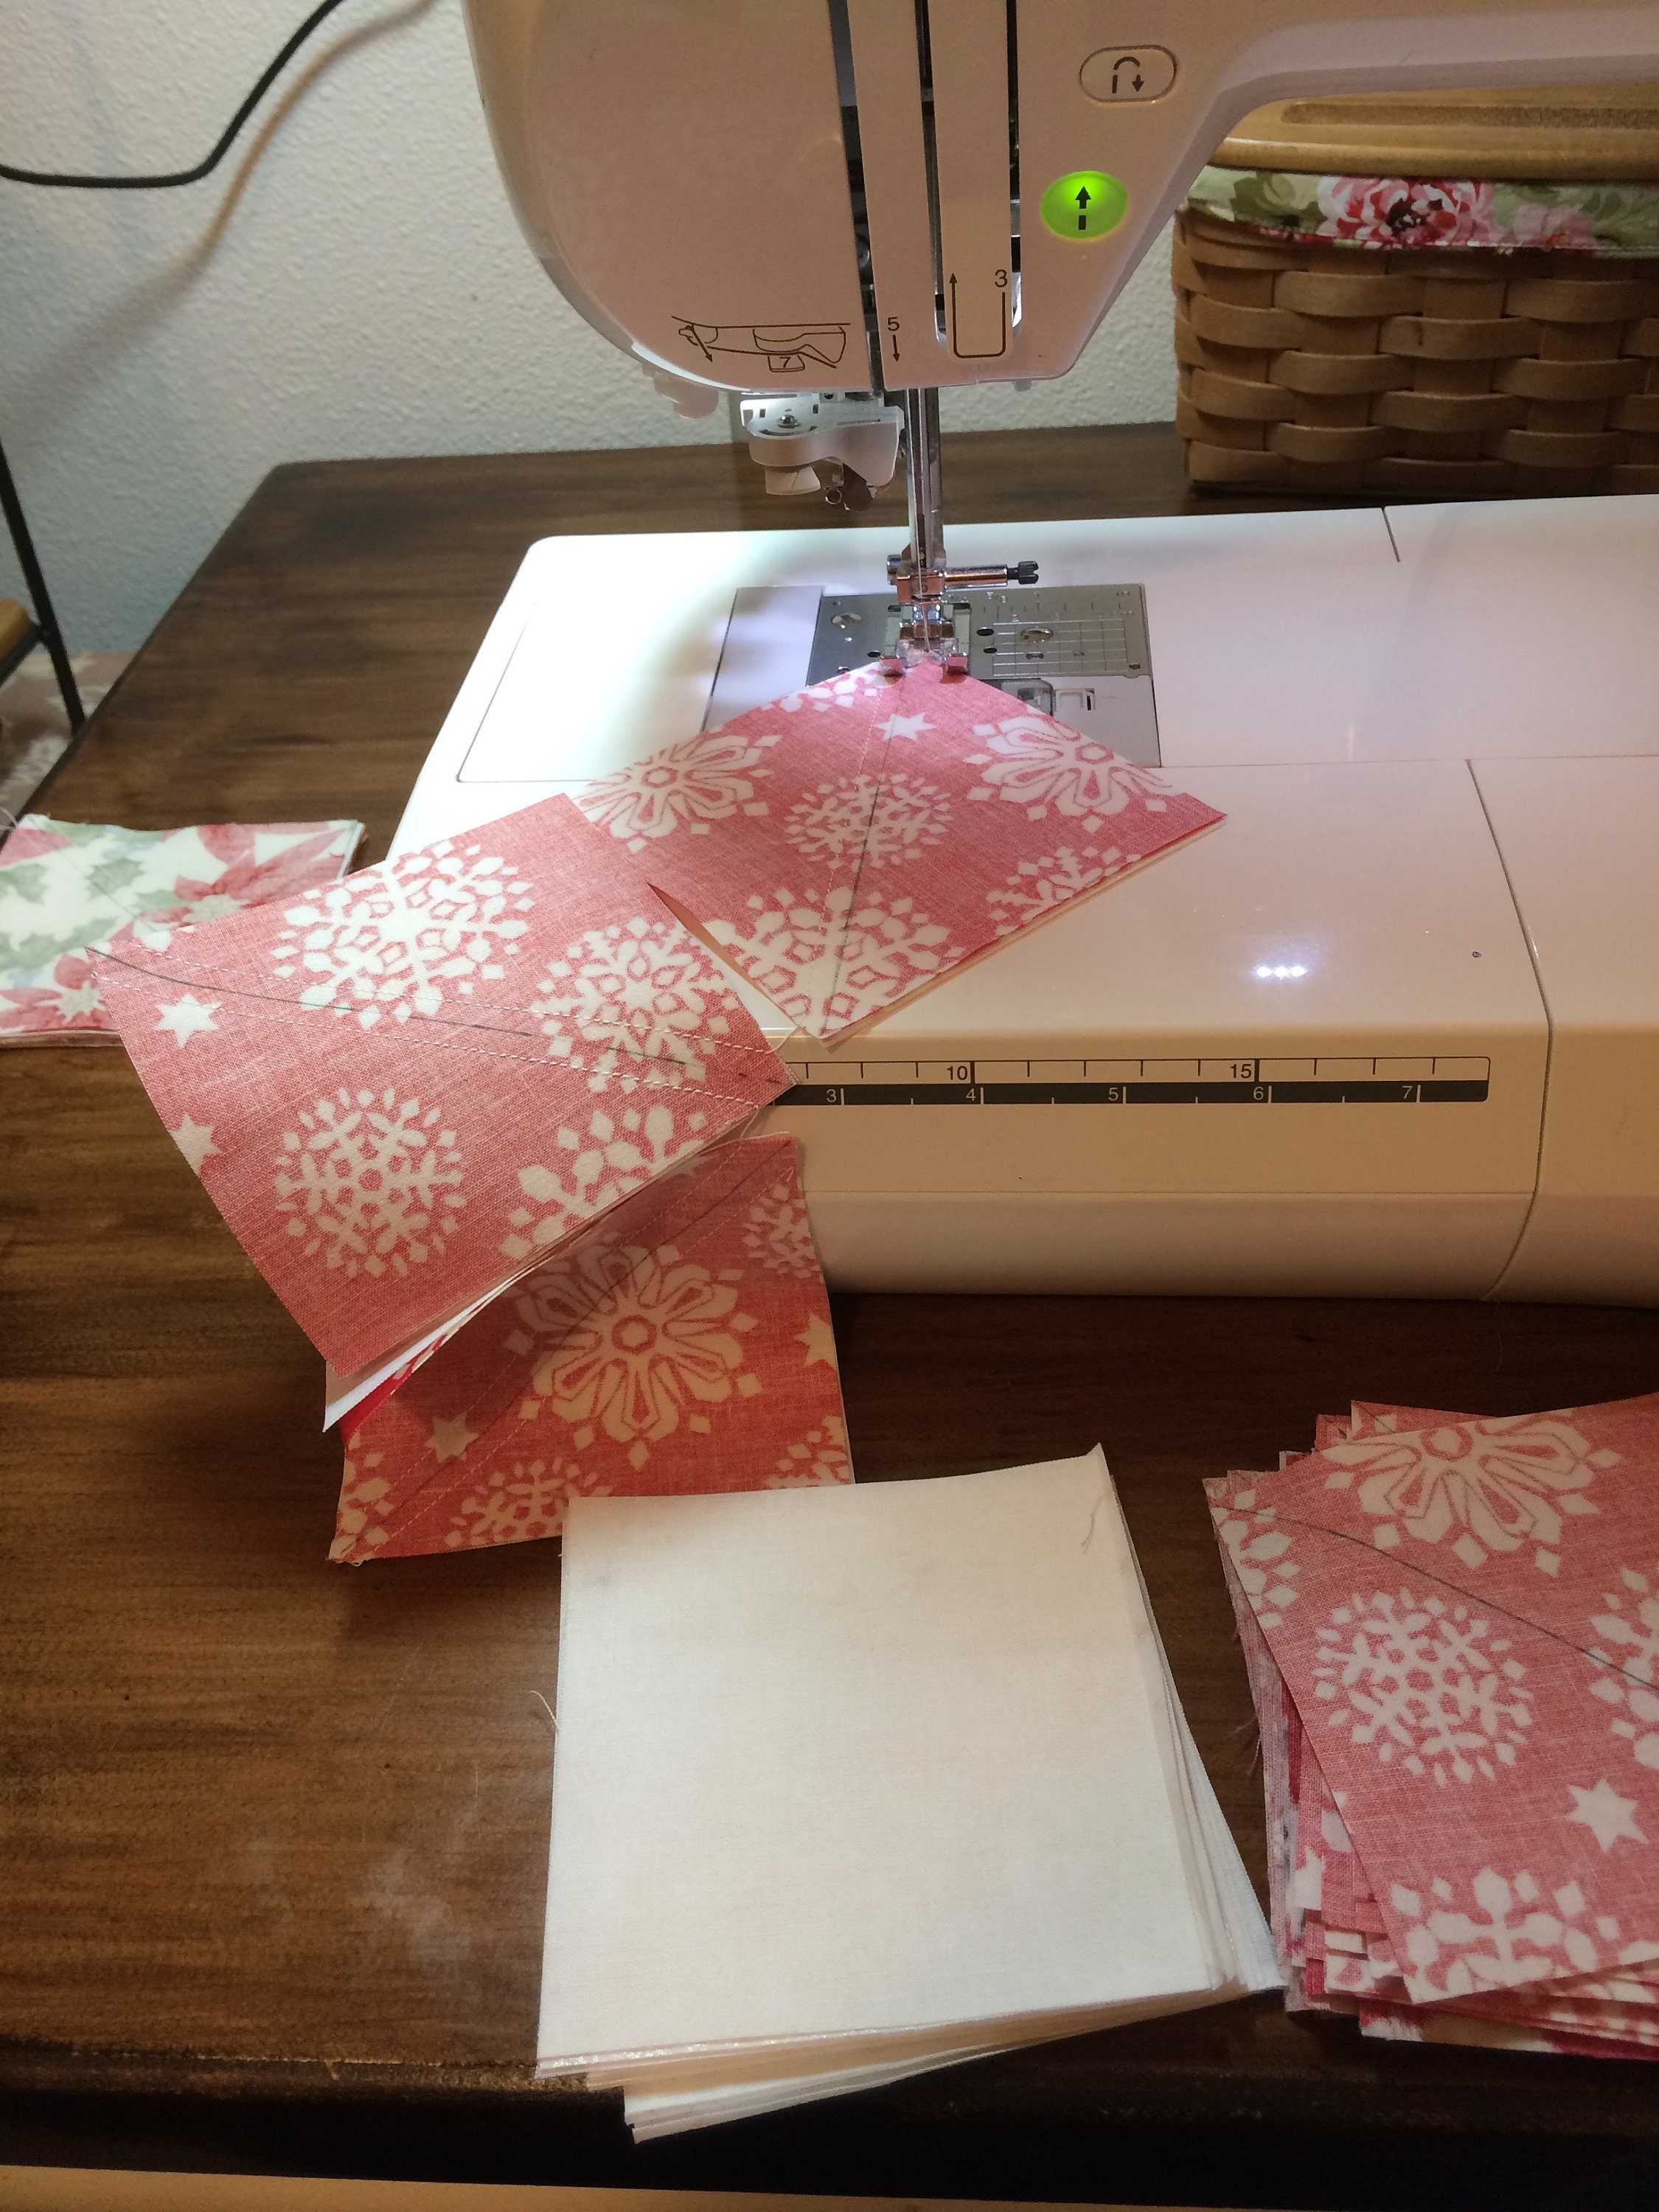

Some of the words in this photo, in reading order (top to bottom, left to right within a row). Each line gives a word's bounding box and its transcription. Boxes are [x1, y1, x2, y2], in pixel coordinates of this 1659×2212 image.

[995, 268, 1008, 288] 3
[887, 316, 900, 332] 5
[779, 355, 792, 369] 7
[947, 1065, 968, 1081] 10
[1230, 1063, 1252, 1079] 15
[826, 1088, 837, 1103] 3
[965, 1088, 976, 1102] 4
[1108, 1087, 1119, 1102] 5
[1253, 1086, 1264, 1101] 6
[1402, 1085, 1413, 1099] 7
